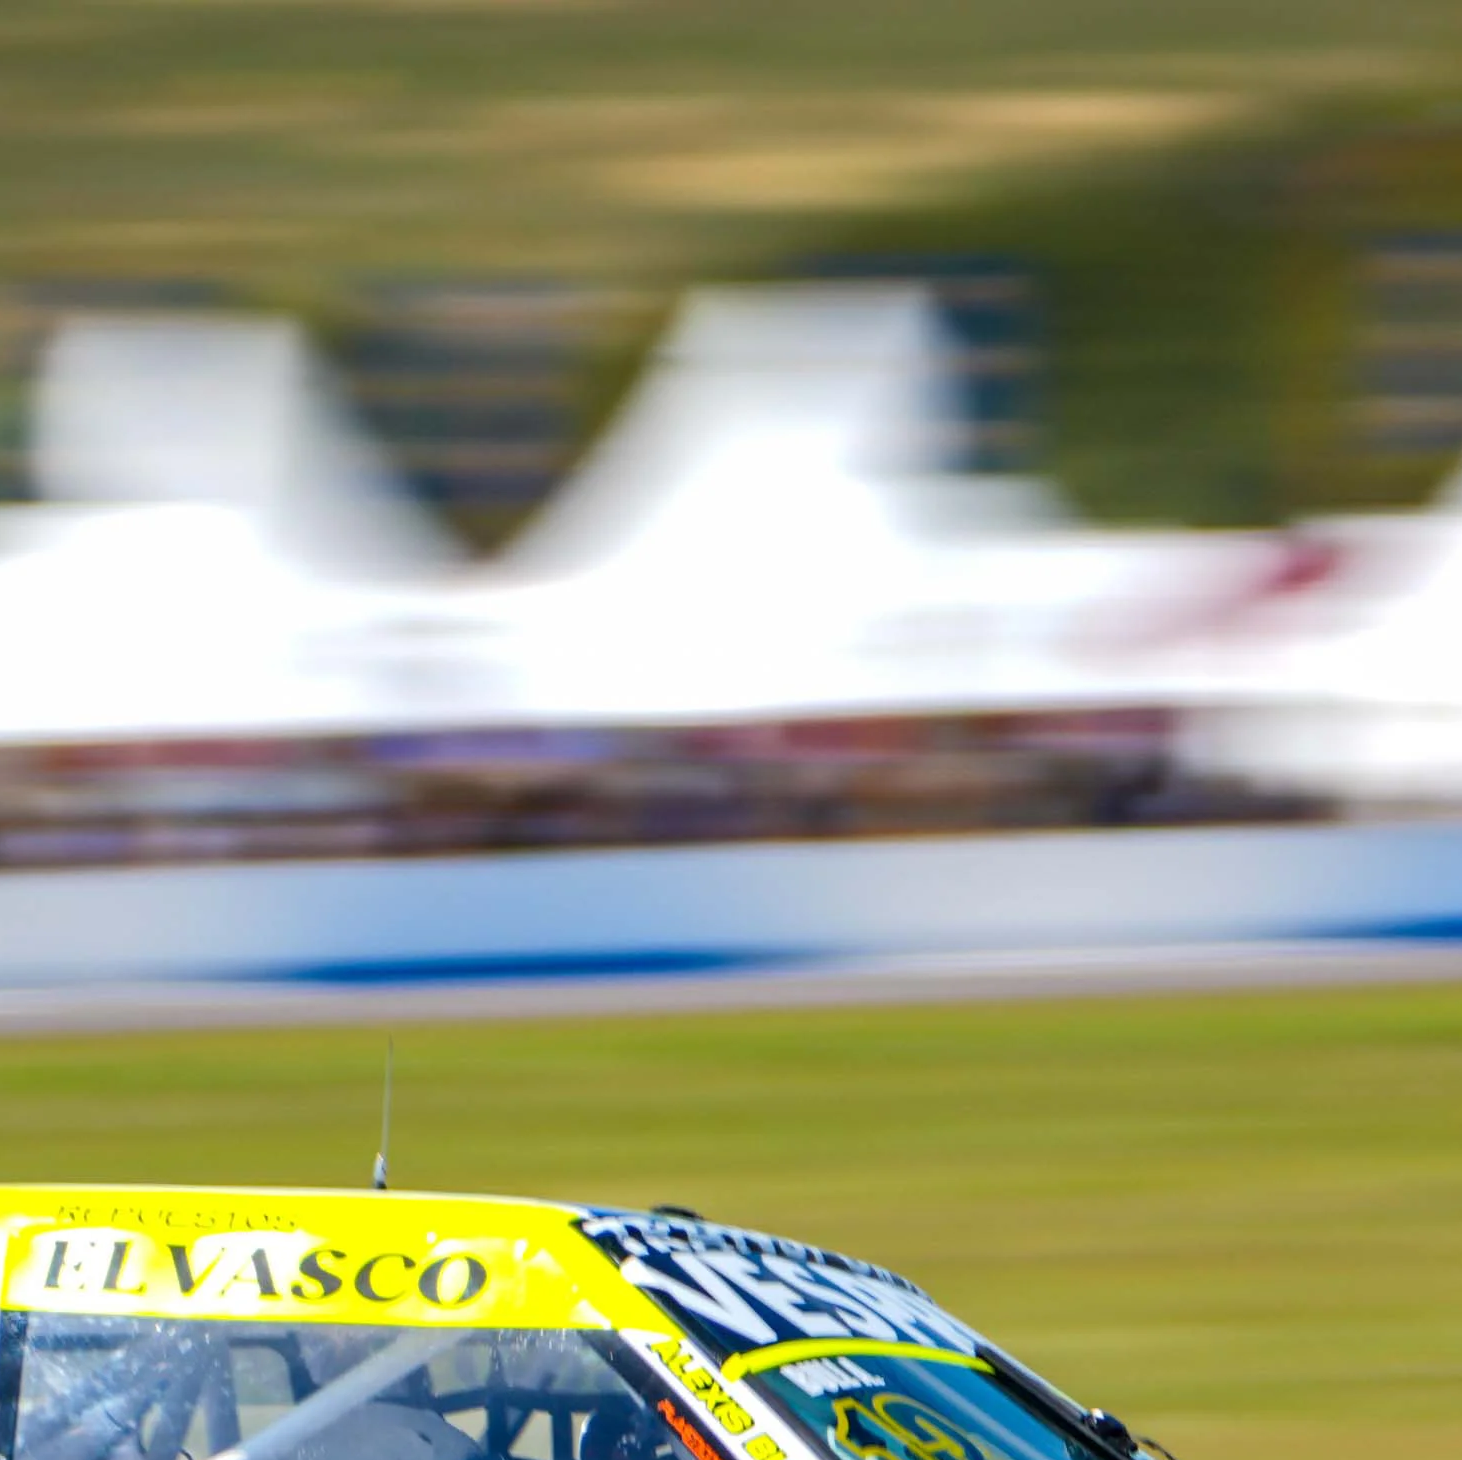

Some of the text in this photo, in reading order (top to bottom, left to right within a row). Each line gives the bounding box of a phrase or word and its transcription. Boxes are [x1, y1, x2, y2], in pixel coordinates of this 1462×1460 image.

[44, 1239, 489, 1308] EL VASCO
[646, 1338, 756, 1436] ALEXIS
